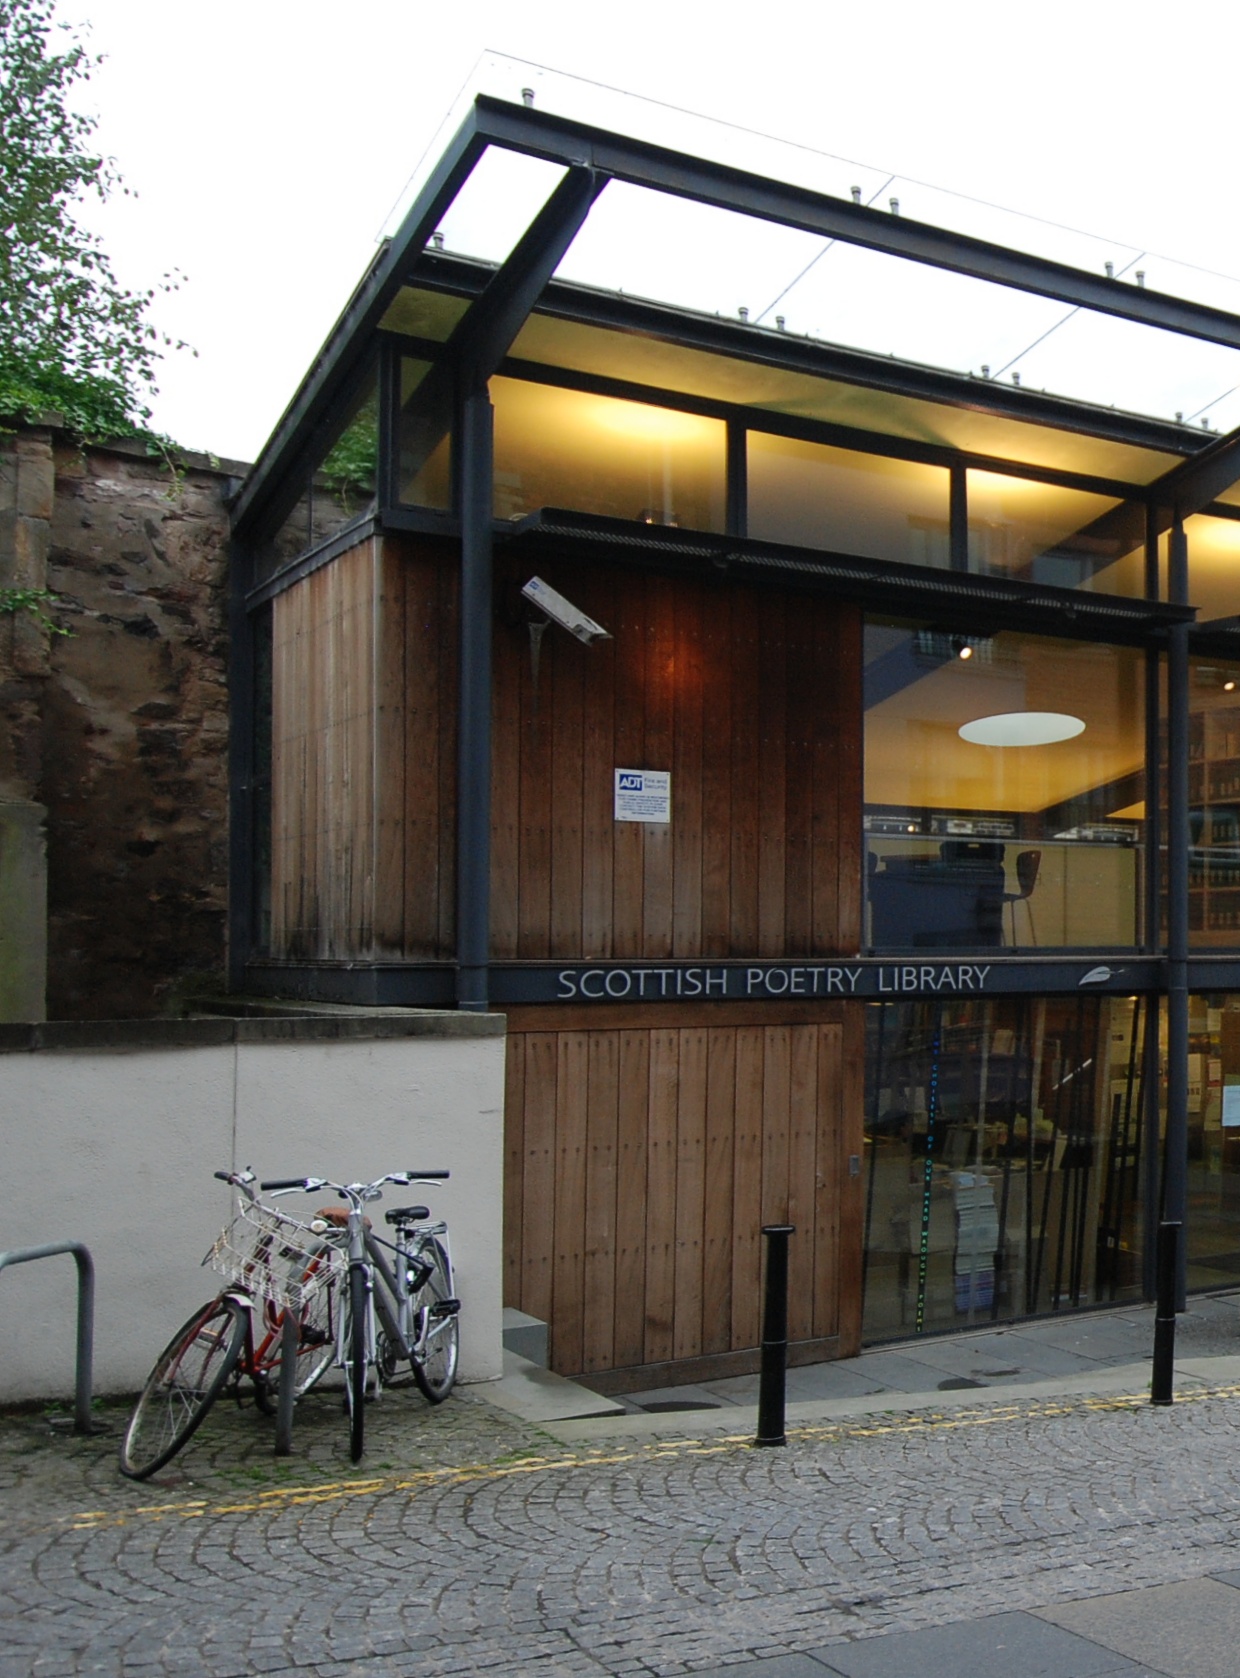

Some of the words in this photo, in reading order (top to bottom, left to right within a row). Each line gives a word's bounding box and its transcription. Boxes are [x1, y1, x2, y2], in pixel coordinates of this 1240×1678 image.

[619, 776, 642, 790] ADT
[556, 968, 728, 998] SCOTTISH
[747, 967, 863, 994] POETRY
[878, 965, 991, 992] LIBRARY
